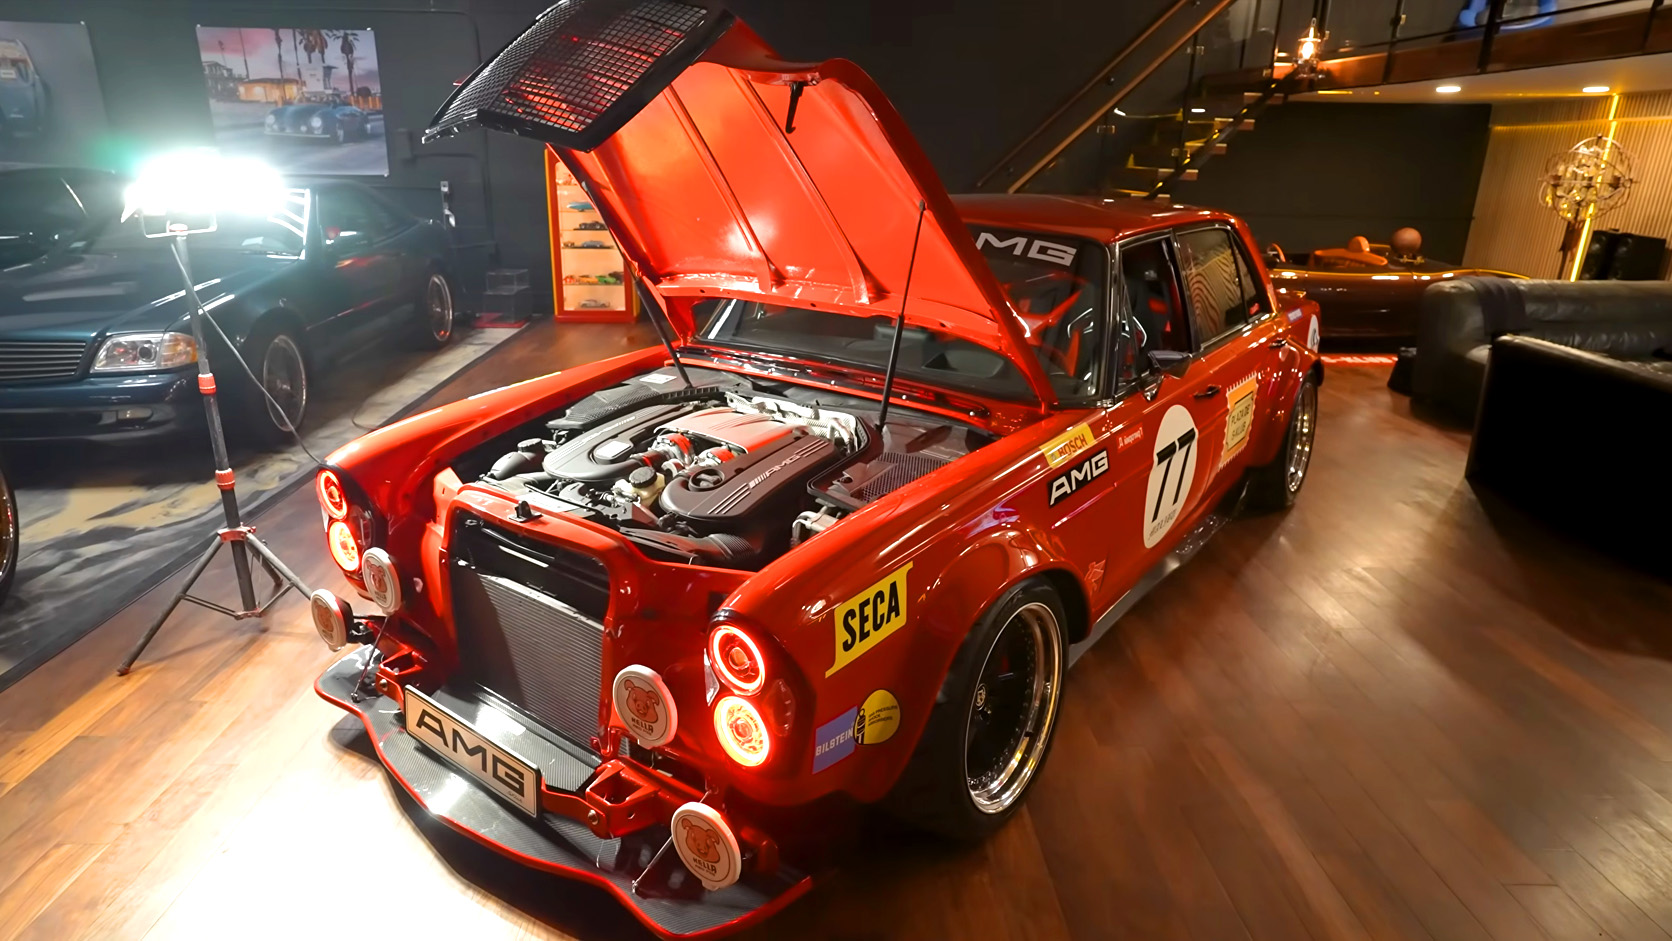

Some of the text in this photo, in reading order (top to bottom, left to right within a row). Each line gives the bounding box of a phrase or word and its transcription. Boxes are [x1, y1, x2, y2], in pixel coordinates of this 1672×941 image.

[976, 232, 1077, 267] MG
[765, 454, 801, 478] AMG
[1057, 433, 1088, 459] BOSCH
[1050, 450, 1109, 506] AMG
[1151, 427, 1196, 523] 77
[842, 580, 900, 652] SECA
[416, 708, 525, 798] AMG
[815, 727, 854, 757] BILSTEIN
